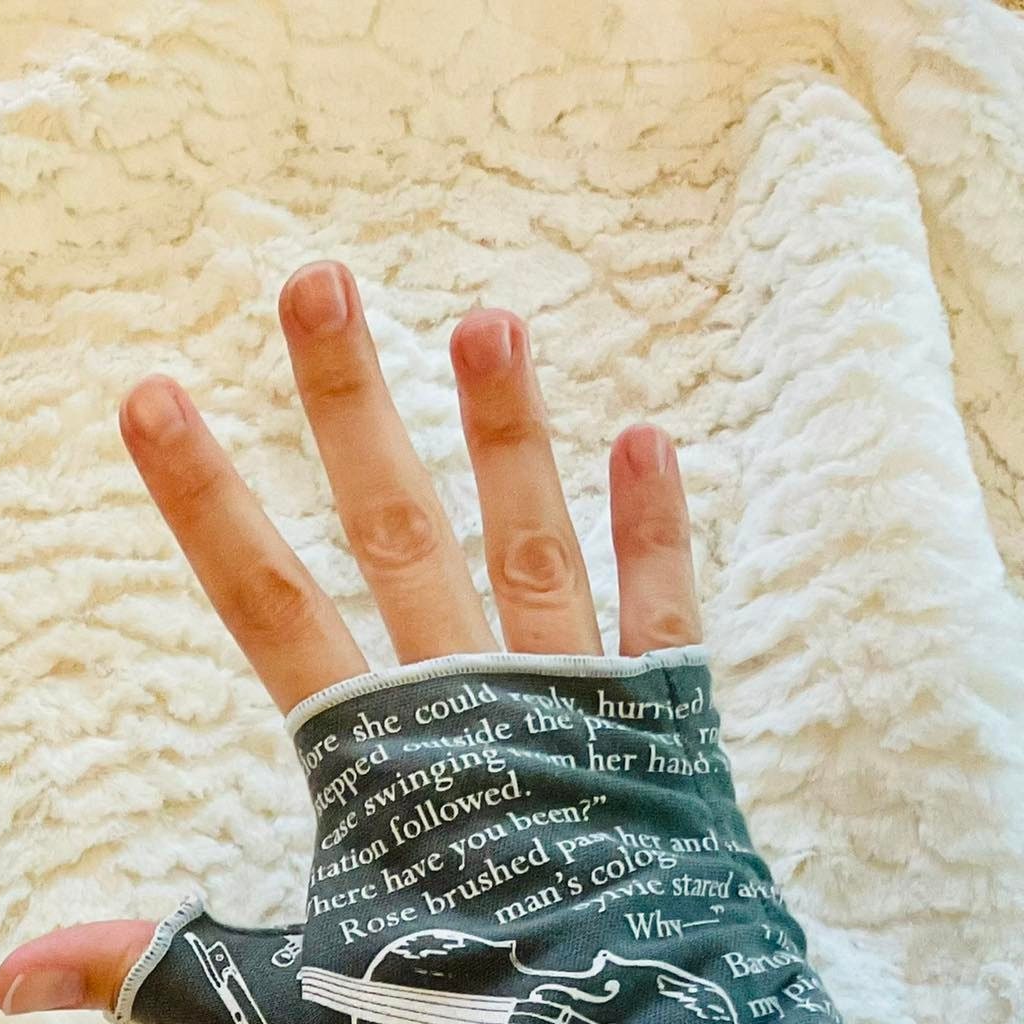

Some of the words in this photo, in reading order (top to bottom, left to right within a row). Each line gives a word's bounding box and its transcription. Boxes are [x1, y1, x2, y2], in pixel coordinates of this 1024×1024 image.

[352, 712, 402, 743] she
[415, 682, 499, 726] could
[597, 687, 704, 720] hurried
[403, 718, 513, 752] outside
[524, 708, 574, 734] the
[321, 811, 358, 851] case
[364, 747, 506, 818] swinging
[587, 743, 637, 772] her
[647, 744, 719, 776] hand.
[389, 770, 531, 847] followed.
[305, 883, 377, 923] here
[380, 852, 444, 894] have
[449, 823, 508, 870] you
[506, 795, 607, 831] been?”
[339, 907, 417, 944] Rose
[422, 837, 550, 915] brushed
[615, 826, 660, 850] her
[671, 828, 719, 852] and
[673, 872, 733, 898] stared
[495, 872, 583, 924] man's
